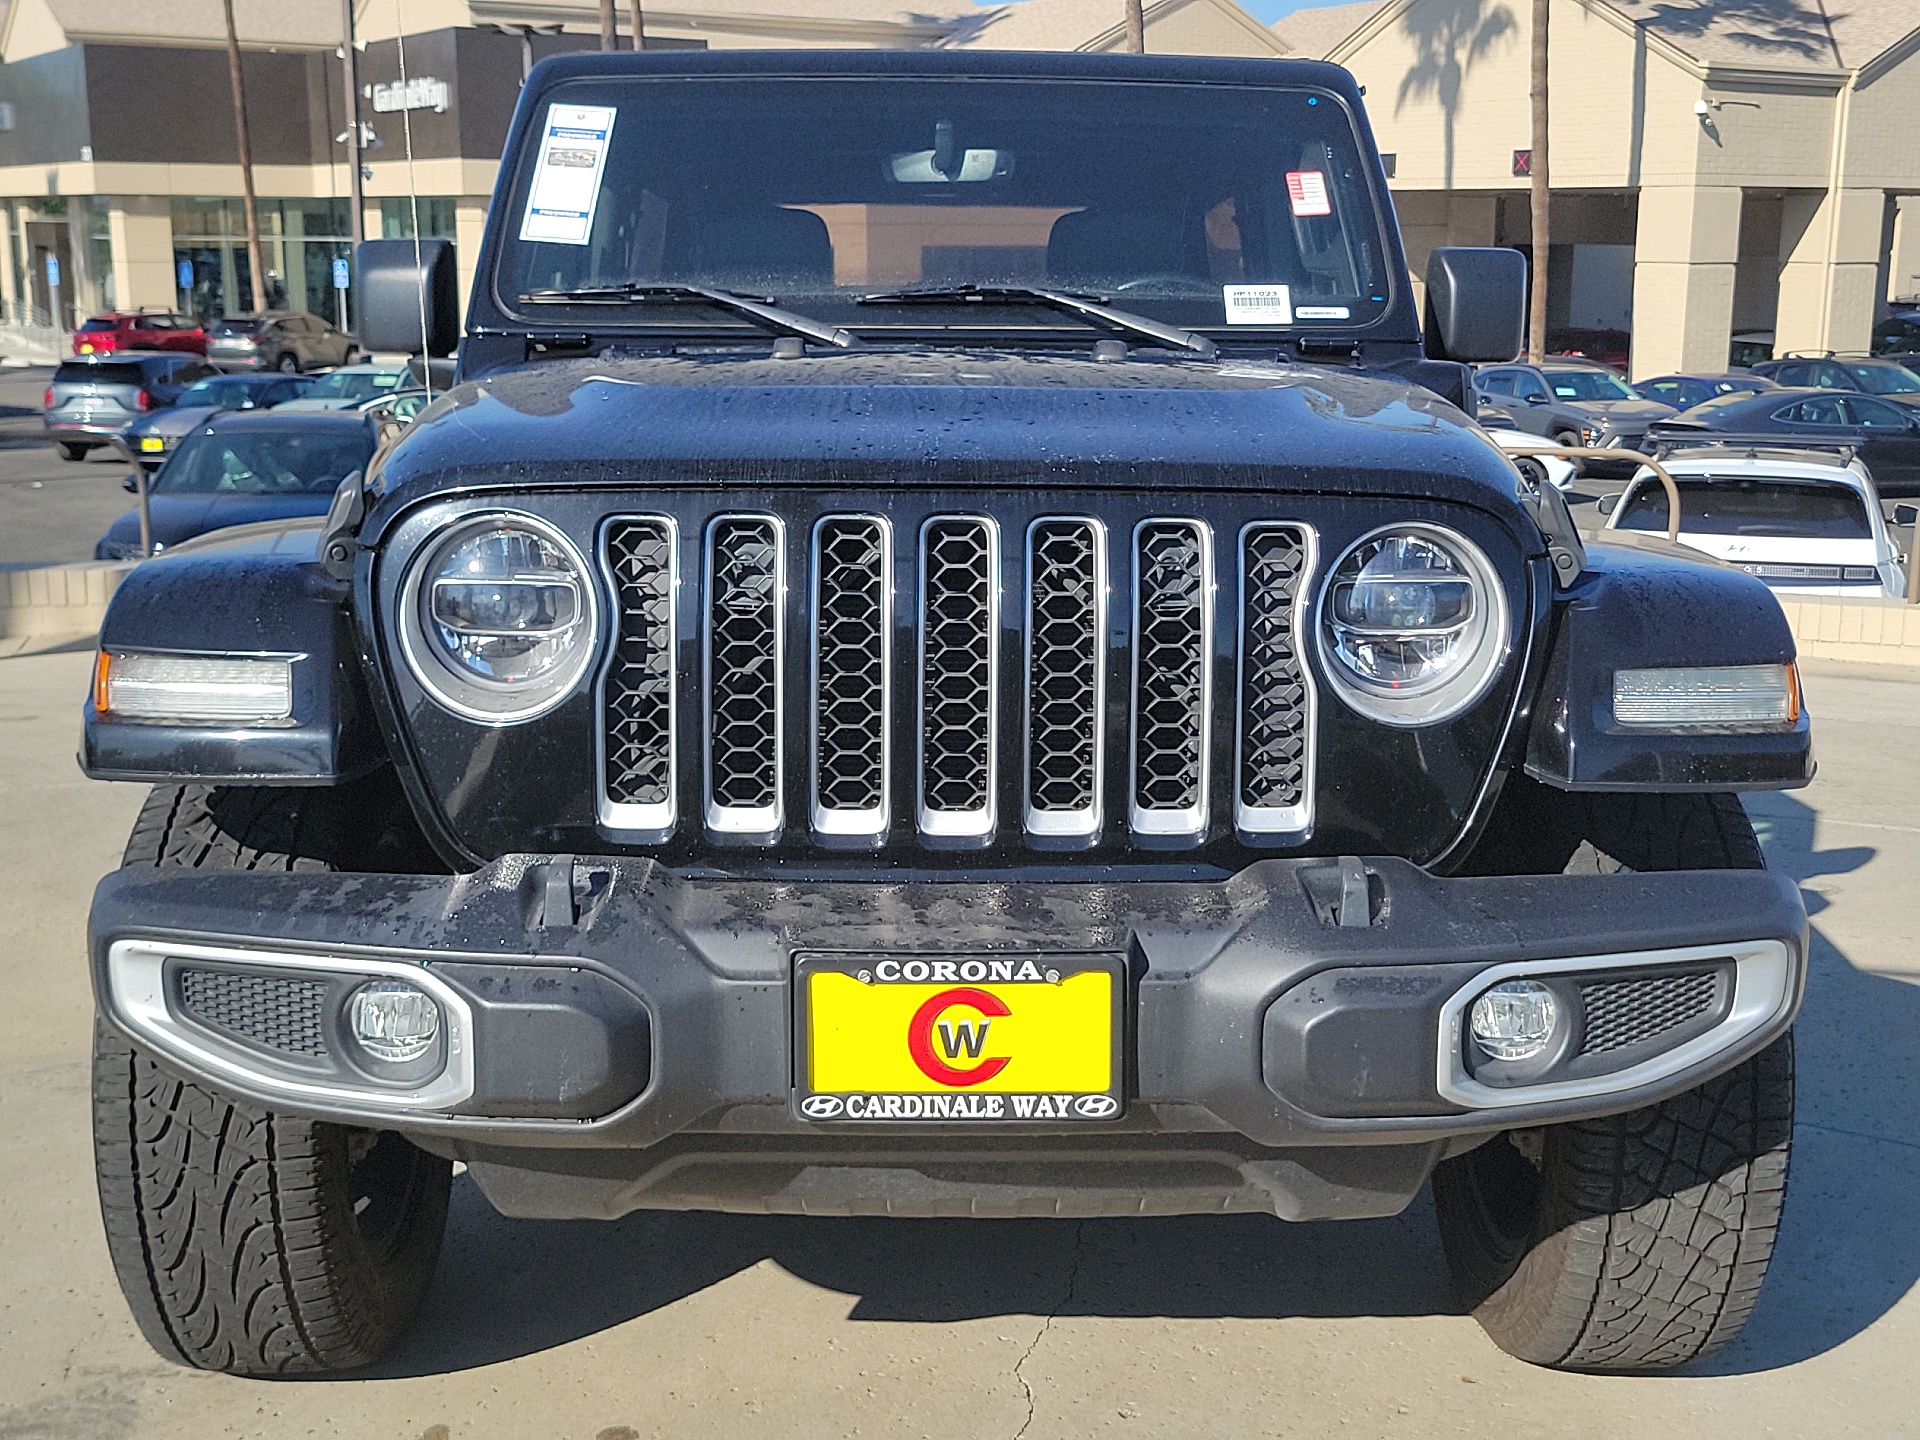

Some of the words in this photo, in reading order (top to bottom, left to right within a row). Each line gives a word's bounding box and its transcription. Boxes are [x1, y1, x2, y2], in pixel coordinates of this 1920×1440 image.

[875, 960, 1044, 982] CORONA
[938, 1019, 991, 1059] W
[845, 1095, 1005, 1118] CARDINALE
[1010, 1095, 1074, 1118] WAY
